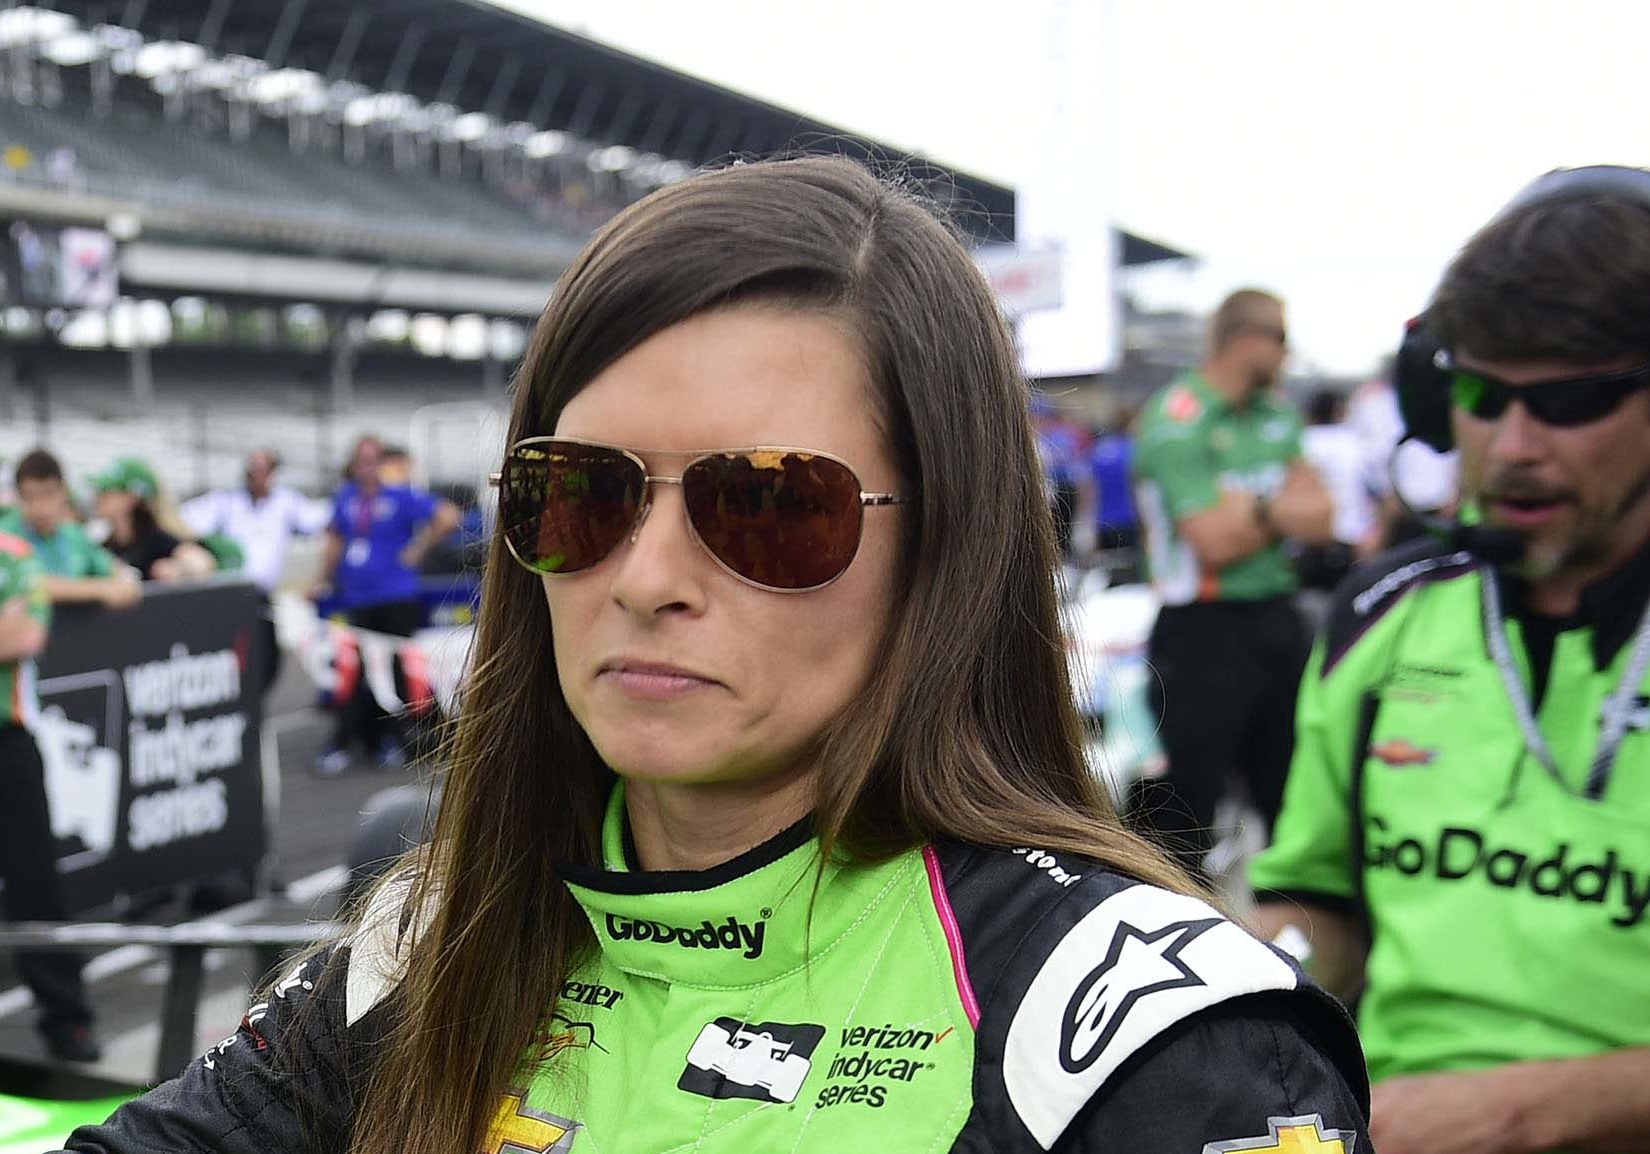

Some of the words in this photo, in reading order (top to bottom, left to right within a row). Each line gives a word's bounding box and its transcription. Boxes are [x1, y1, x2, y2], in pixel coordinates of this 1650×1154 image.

[124, 643, 241, 716] verizon
[128, 710, 247, 787] indycar
[128, 778, 229, 850] series
[605, 911, 766, 960] GoDaddy
[841, 1024, 934, 1050] verizon
[826, 1051, 924, 1084] indycar
[814, 1084, 888, 1109] series
